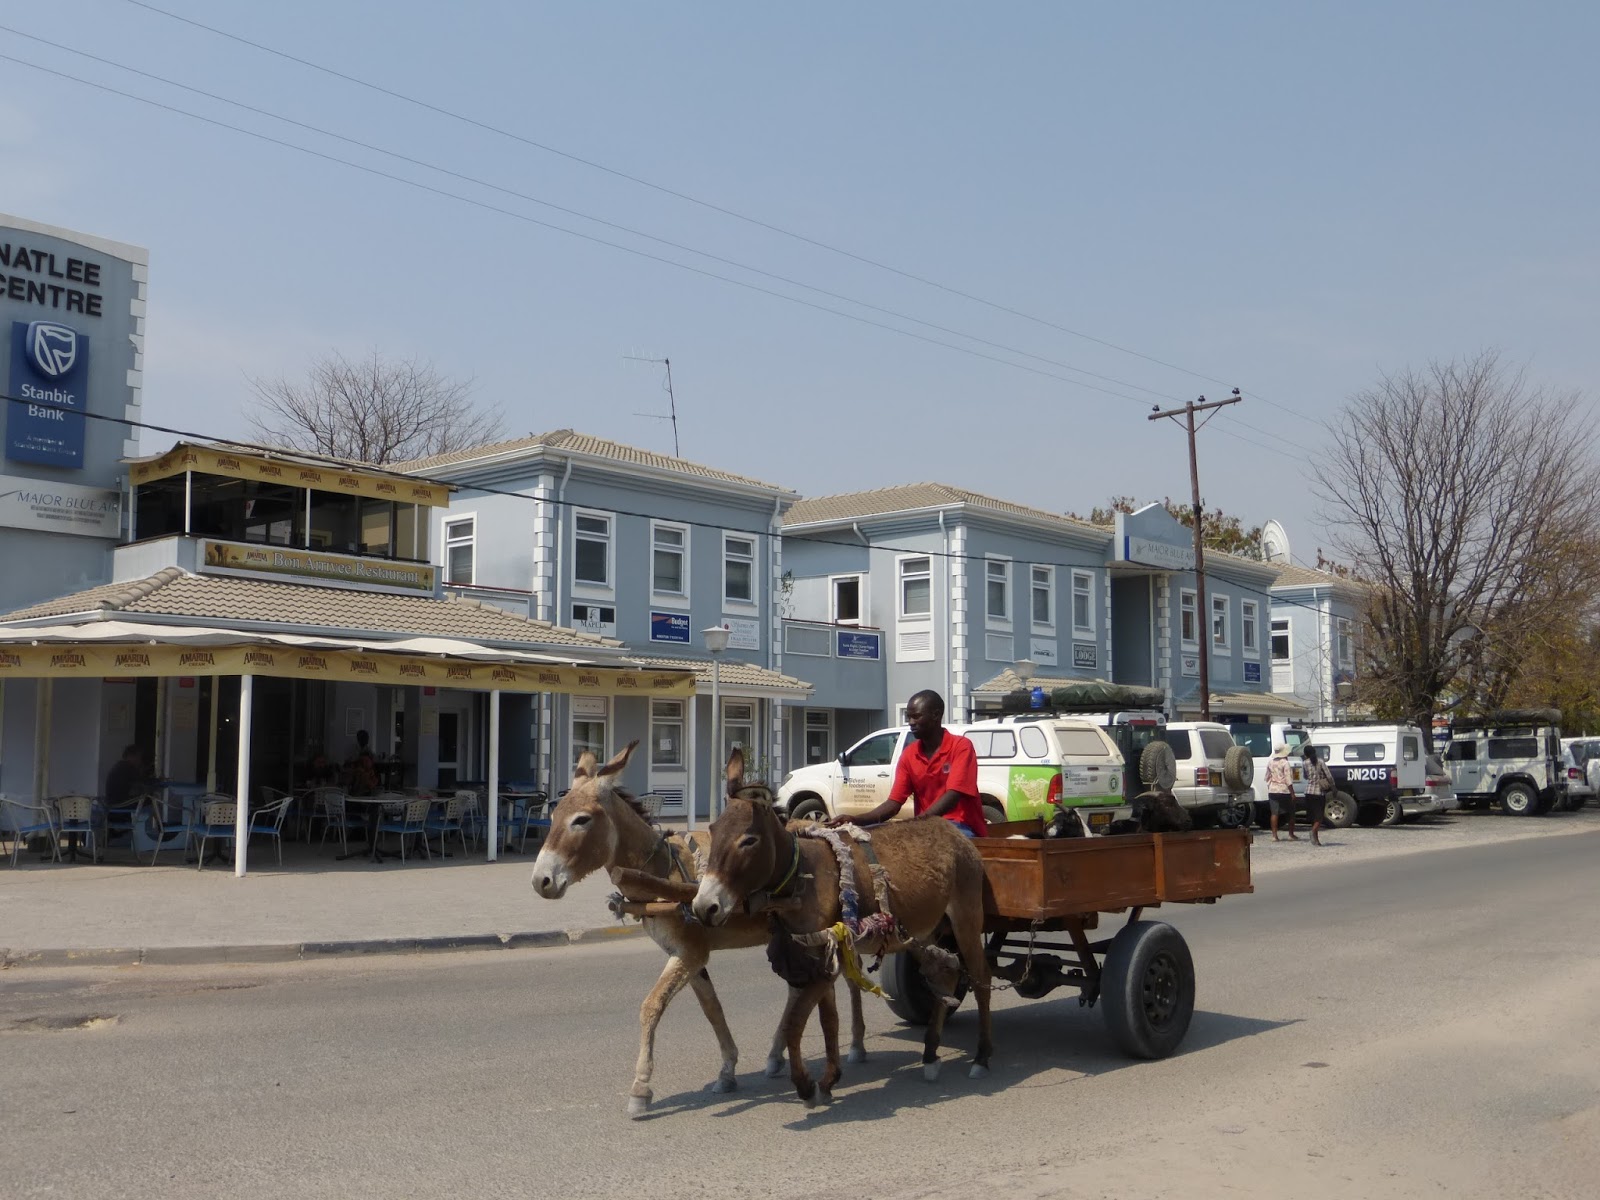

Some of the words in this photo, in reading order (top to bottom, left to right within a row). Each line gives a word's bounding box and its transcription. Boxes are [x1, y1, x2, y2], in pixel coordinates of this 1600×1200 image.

[21, 383, 75, 405] Stanbic
[28, 403, 65, 422] Bank
[17, 491, 62, 507] MAJOR
[65, 497, 97, 511] BLUE
[98, 502, 119, 514] AIR
[272, 551, 301, 569] Bon
[355, 563, 419, 583] Restaurant
[671, 616, 689, 629] Budget
[50, 654, 86, 667] AMARULA
[114, 653, 151, 667] AMARULA
[179, 652, 215, 667] AMARULA
[1075, 650, 1096, 661] LODGE
[1347, 768, 1387, 781] DN205
